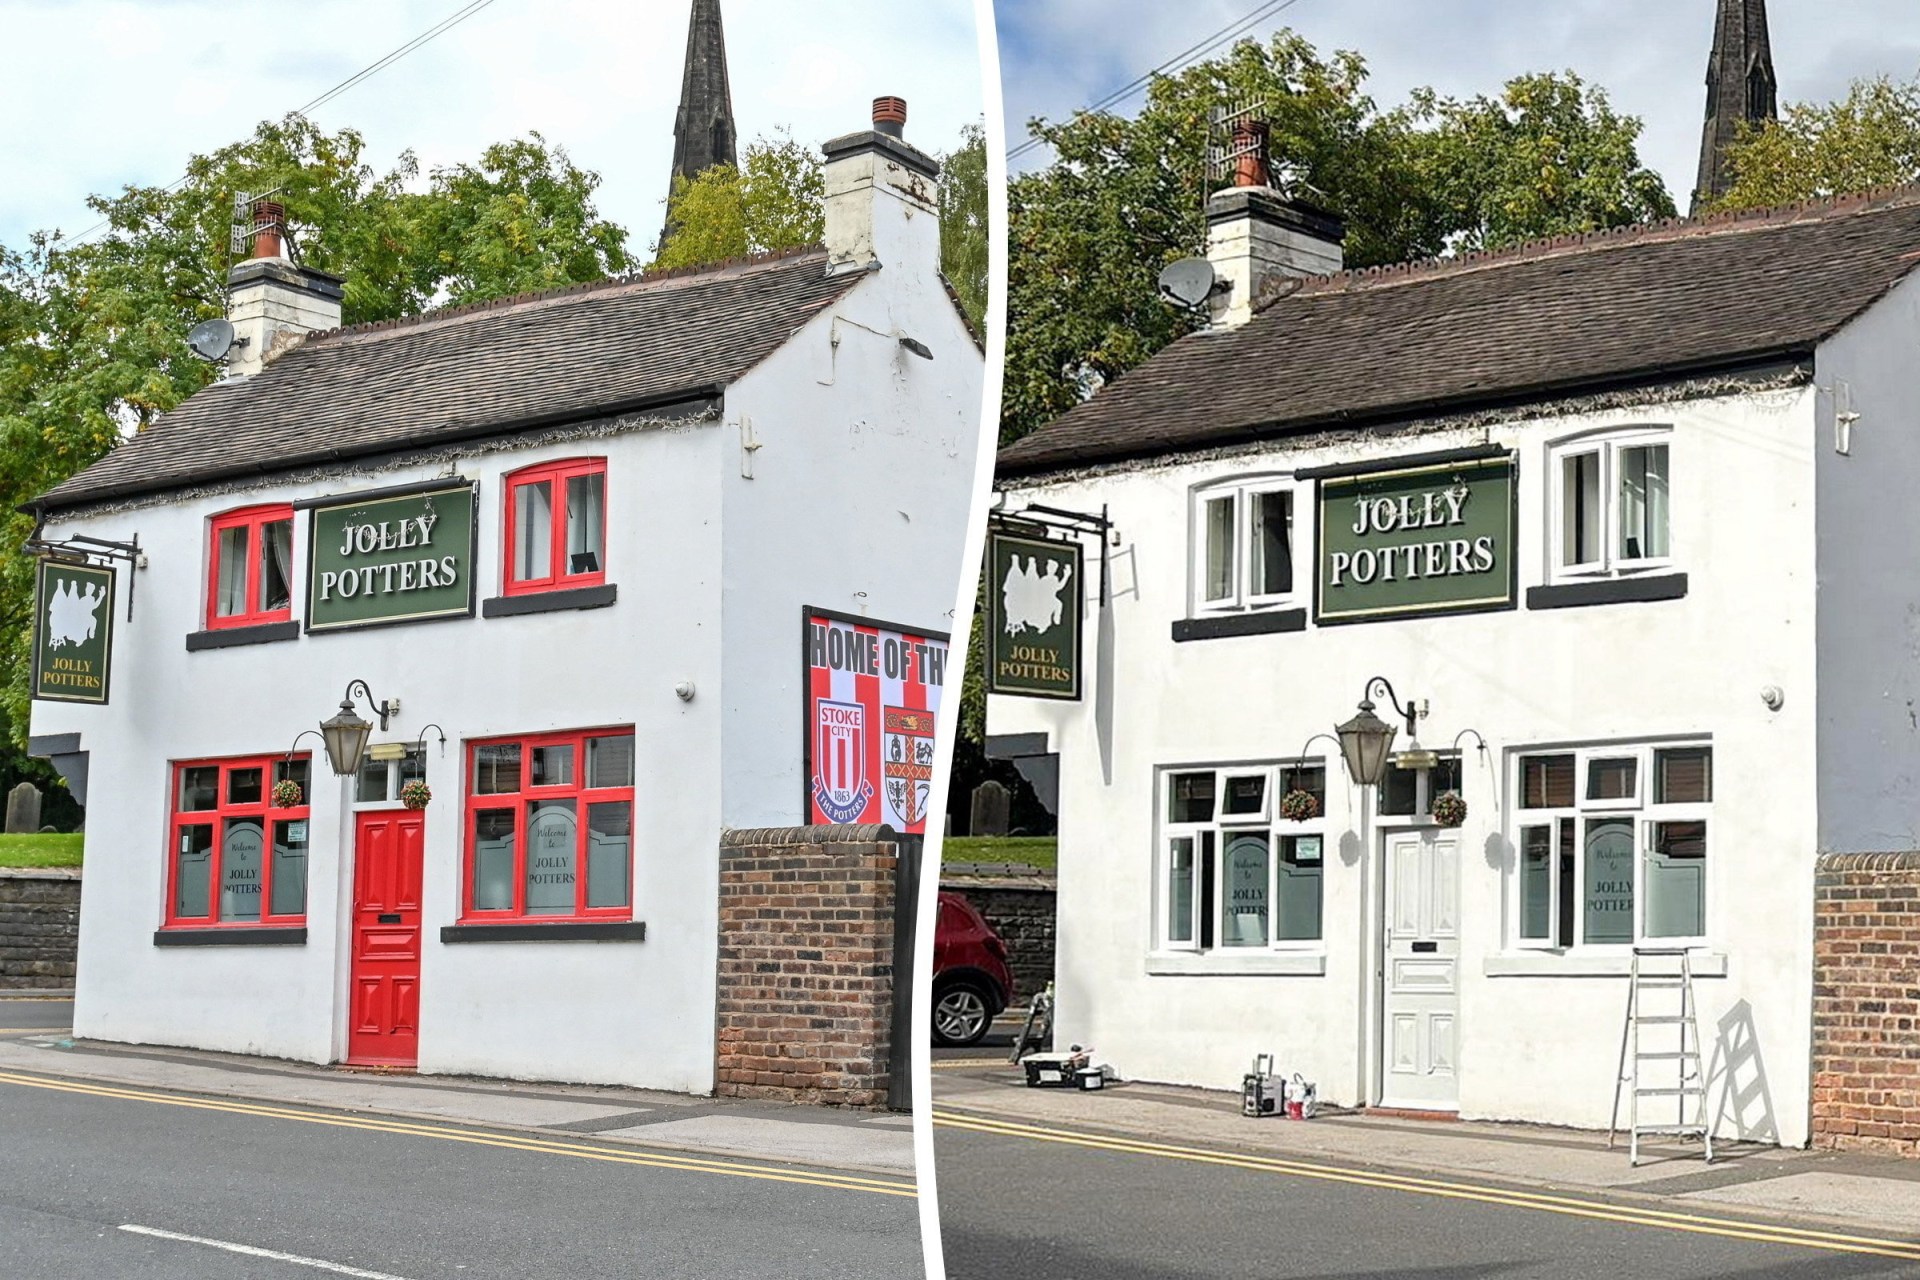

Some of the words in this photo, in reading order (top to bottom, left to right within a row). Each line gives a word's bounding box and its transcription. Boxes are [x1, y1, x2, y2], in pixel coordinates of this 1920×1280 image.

[1352, 487, 1468, 535] JOLLY
[340, 516, 437, 556] JOLLY
[1331, 536, 1493, 586] POTTERS
[320, 555, 457, 601] POTTERS
[811, 624, 879, 676] HOME
[884, 638, 911, 680] OF
[1010, 645, 1059, 664] JOLLY
[52, 657, 93, 672] JOLLY
[1000, 661, 1070, 682] POTTERS
[43, 671, 100, 689] POTTERS
[822, 707, 860, 726] STOKE
[831, 725, 851, 738] CITY
[834, 790, 850, 803] 1863
[820, 794, 832, 815] THE
[833, 797, 864, 820] POTTERS
[537, 827, 567, 838] Welcome
[231, 842, 256, 852] Welcome
[548, 839, 555, 848] to
[240, 852, 247, 861] to
[535, 857, 568, 868] JOLLY
[229, 869, 257, 880] JOLLY
[529, 873, 575, 885] POTTERS
[224, 883, 262, 894] POTTERS
[1595, 881, 1633, 893] JOLLY
[1233, 888, 1263, 900] JOLLY
[1587, 899, 1633, 912] POTTER
